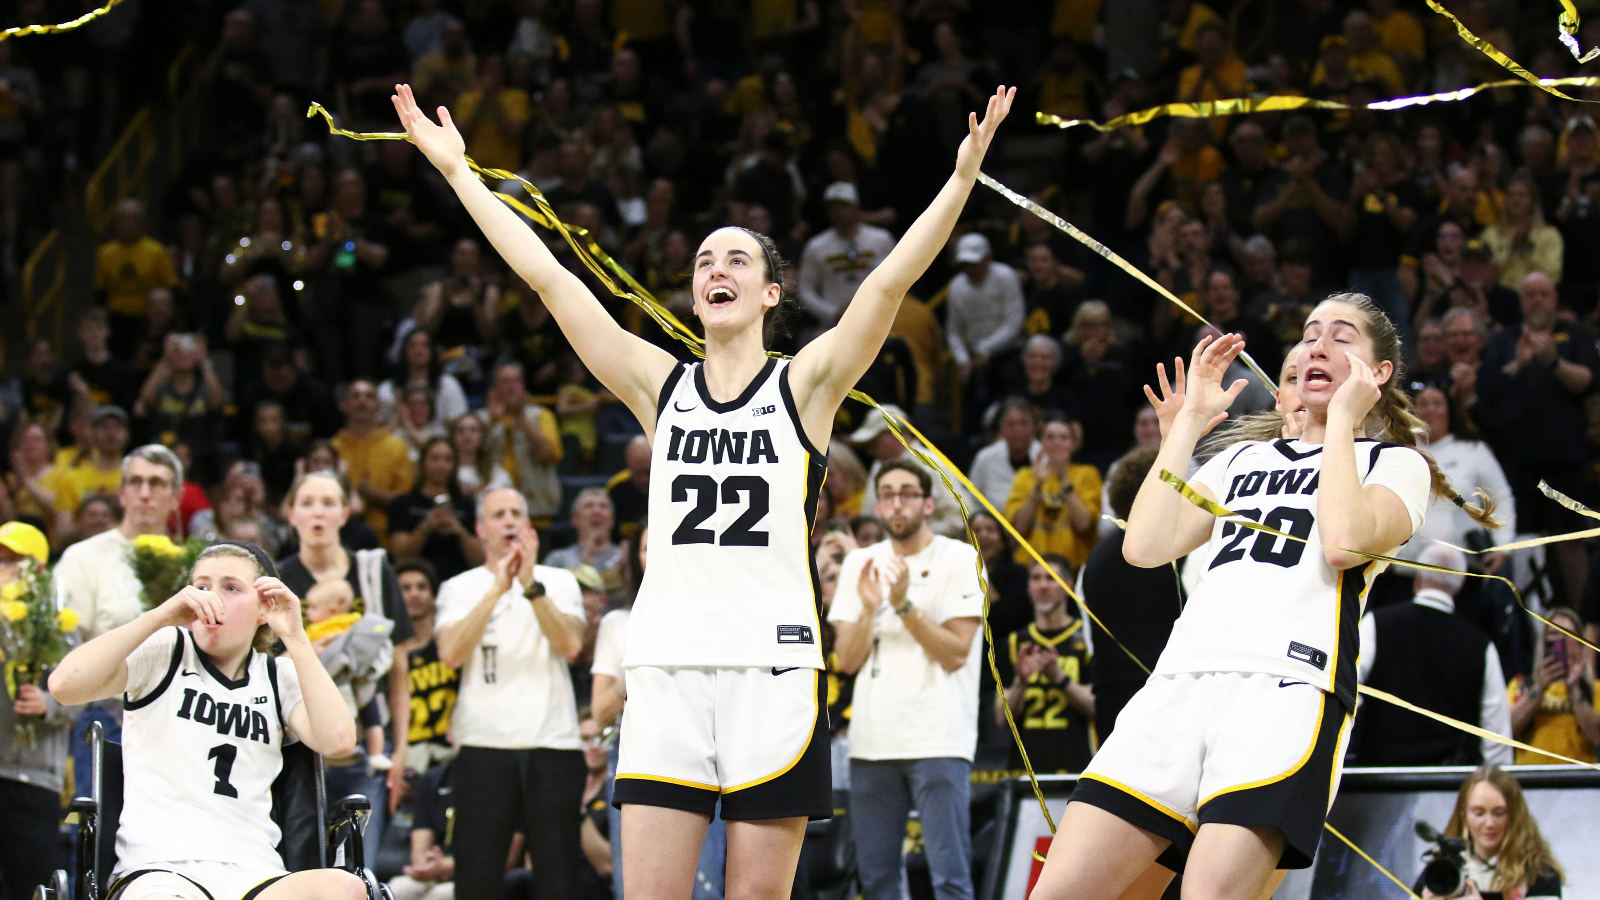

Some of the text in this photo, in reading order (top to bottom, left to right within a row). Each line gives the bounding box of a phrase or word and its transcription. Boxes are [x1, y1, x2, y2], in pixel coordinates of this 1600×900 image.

[667, 425, 779, 465] IOWA
[671, 474, 769, 547] 22
[1207, 506, 1315, 572] 20
[803, 630, 810, 638] M
[1316, 654, 1321, 663] L
[176, 687, 271, 745] IOWA
[1023, 687, 1069, 729] 22
[207, 743, 238, 799] 1
